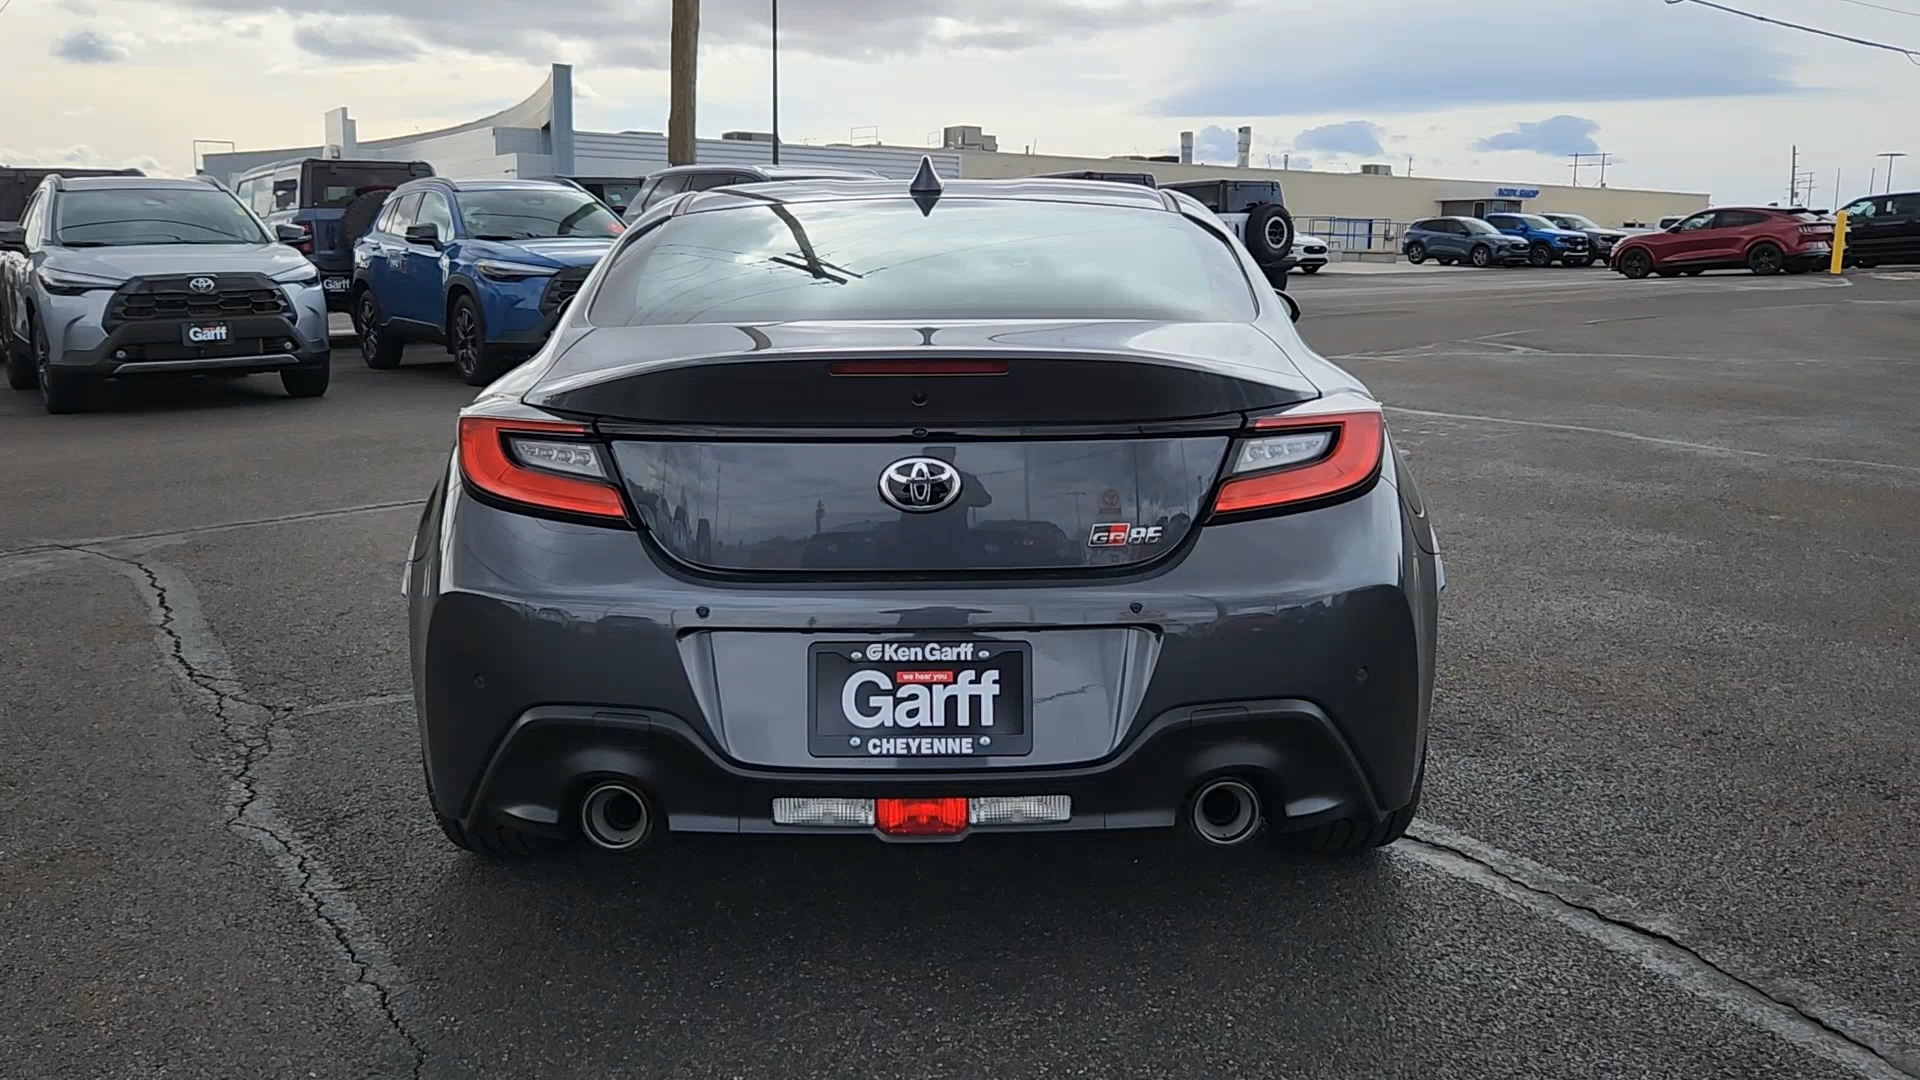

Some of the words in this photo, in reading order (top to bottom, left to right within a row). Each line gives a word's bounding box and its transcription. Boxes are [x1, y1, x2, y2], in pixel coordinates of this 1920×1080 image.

[1519, 189, 1539, 198] SHOP
[188, 326, 227, 341] Garff
[884, 644, 921, 661] Ken
[924, 643, 974, 661] Garff
[903, 673, 914, 681] we
[914, 672, 932, 680] hear
[932, 673, 948, 682] you
[841, 669, 1000, 728] Garff
[867, 737, 974, 755] CHEYENNE
